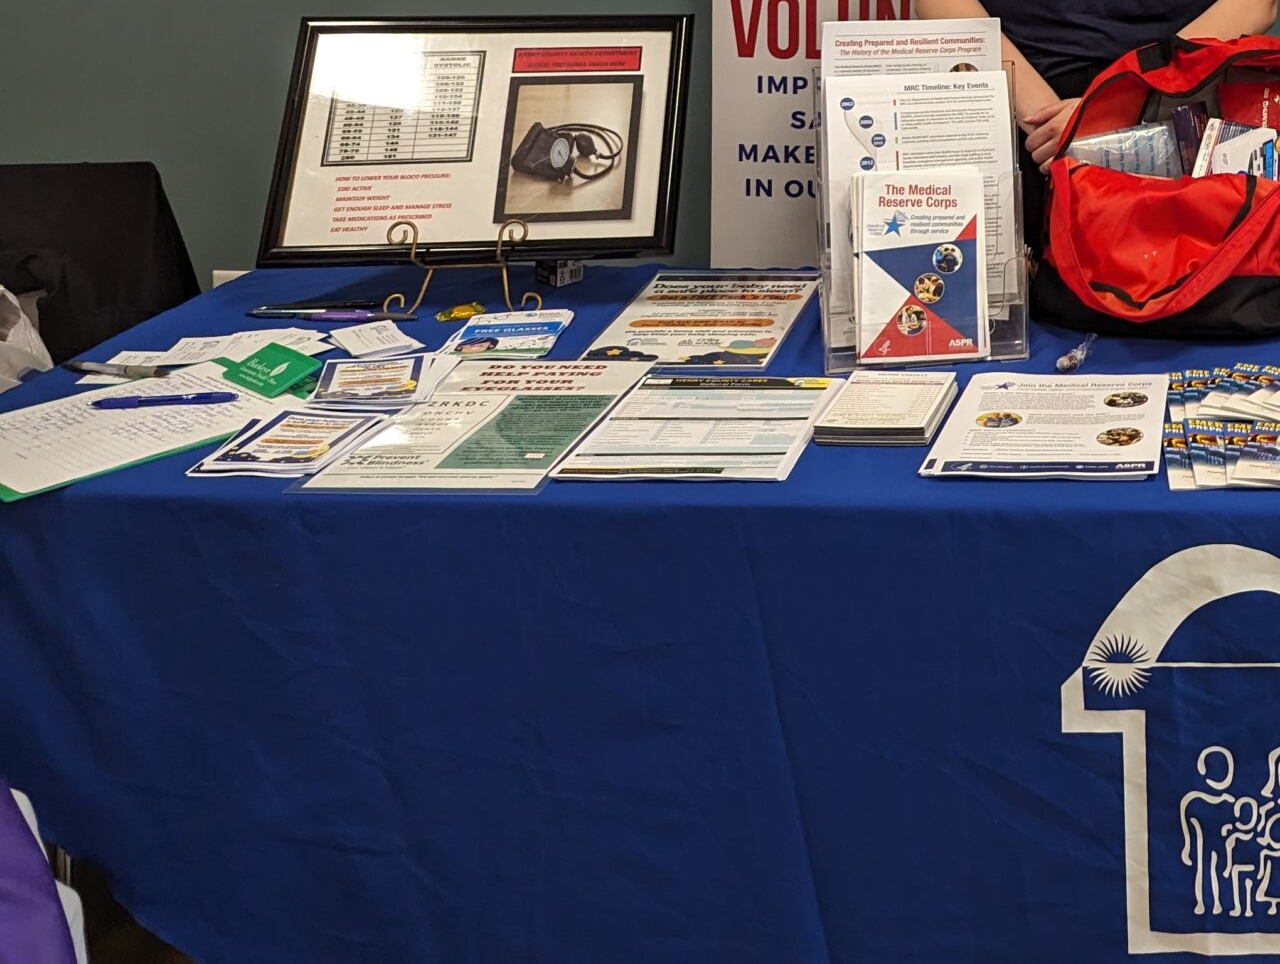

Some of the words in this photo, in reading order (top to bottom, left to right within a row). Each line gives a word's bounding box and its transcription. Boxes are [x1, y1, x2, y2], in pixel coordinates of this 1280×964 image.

[834, 39, 863, 48] Creating
[864, 38, 895, 48] Prepared
[896, 38, 909, 46] and
[910, 37, 939, 46] Resilient
[940, 37, 986, 45] Communities:
[851, 48, 872, 57] History
[891, 47, 914, 55] Medical
[939, 47, 956, 55] Corps
[957, 46, 982, 55] Program
[904, 84, 920, 92] MRC
[922, 83, 951, 91] Timeline:
[952, 83, 966, 91] Key
[738, 143, 815, 164] MAKE
[746, 178, 773, 197] IN
[885, 184, 905, 196] The
[908, 184, 952, 196] Medical
[878, 196, 923, 208] Reserve
[926, 196, 958, 210] Corps
[910, 214, 932, 222] Creating
[932, 214, 955, 222] prepared
[949, 338, 973, 347] ASPR
